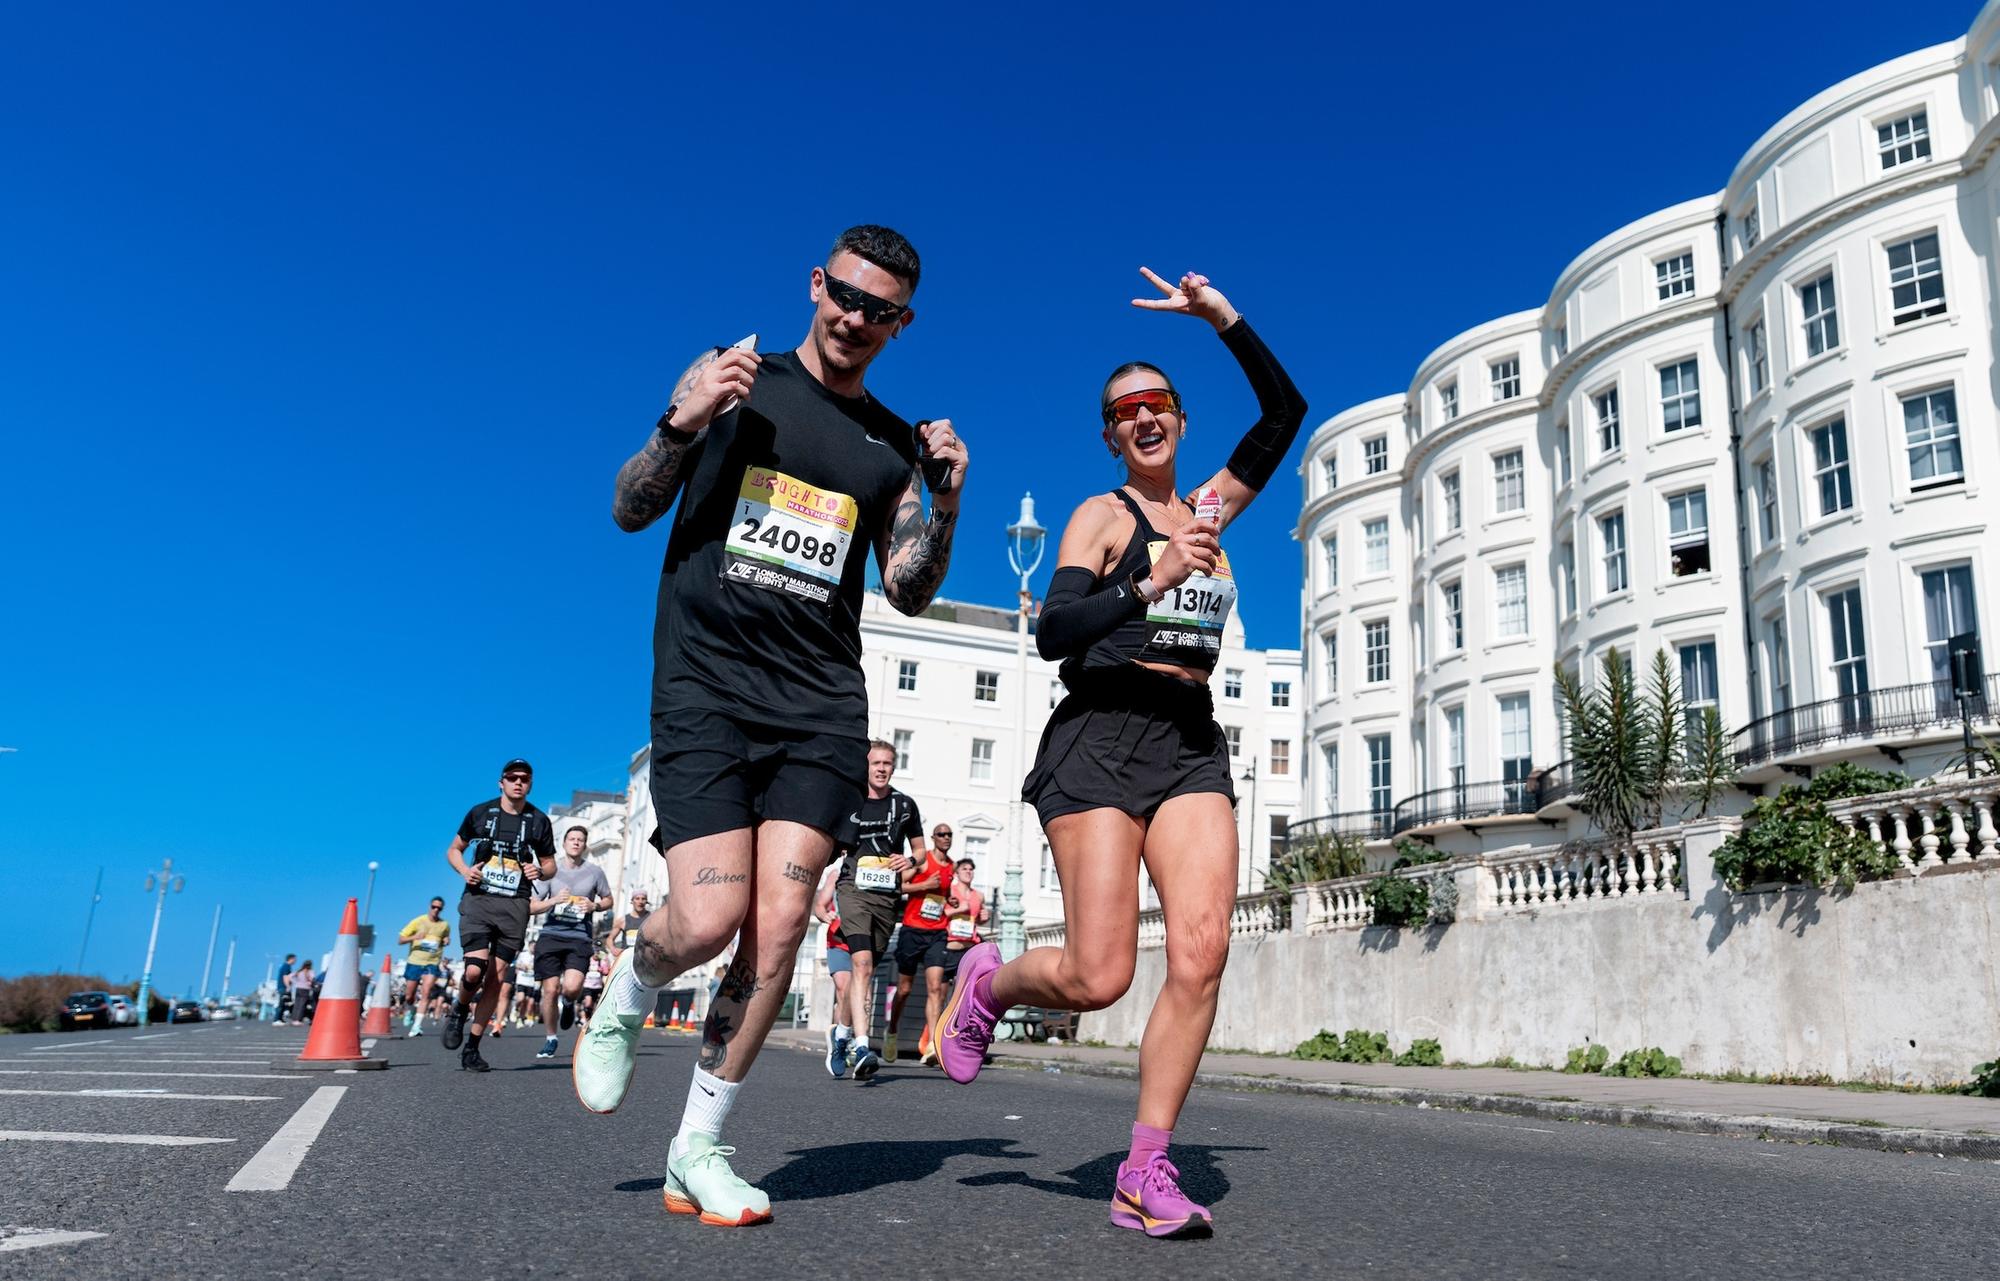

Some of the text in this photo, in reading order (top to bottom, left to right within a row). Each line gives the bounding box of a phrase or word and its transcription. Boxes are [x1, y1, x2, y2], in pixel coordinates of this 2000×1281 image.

[787, 501, 834, 522] MARATHON
[740, 518, 837, 567] 24098
[755, 575, 783, 588] EVENTS
[756, 567, 789, 583] LONDON
[789, 577, 830, 597] MARATHON
[1174, 587, 1223, 616] 13114
[1178, 639, 1203, 647] EVENTS
[486, 871, 516, 885] 15048
[862, 872, 891, 884] 16289
